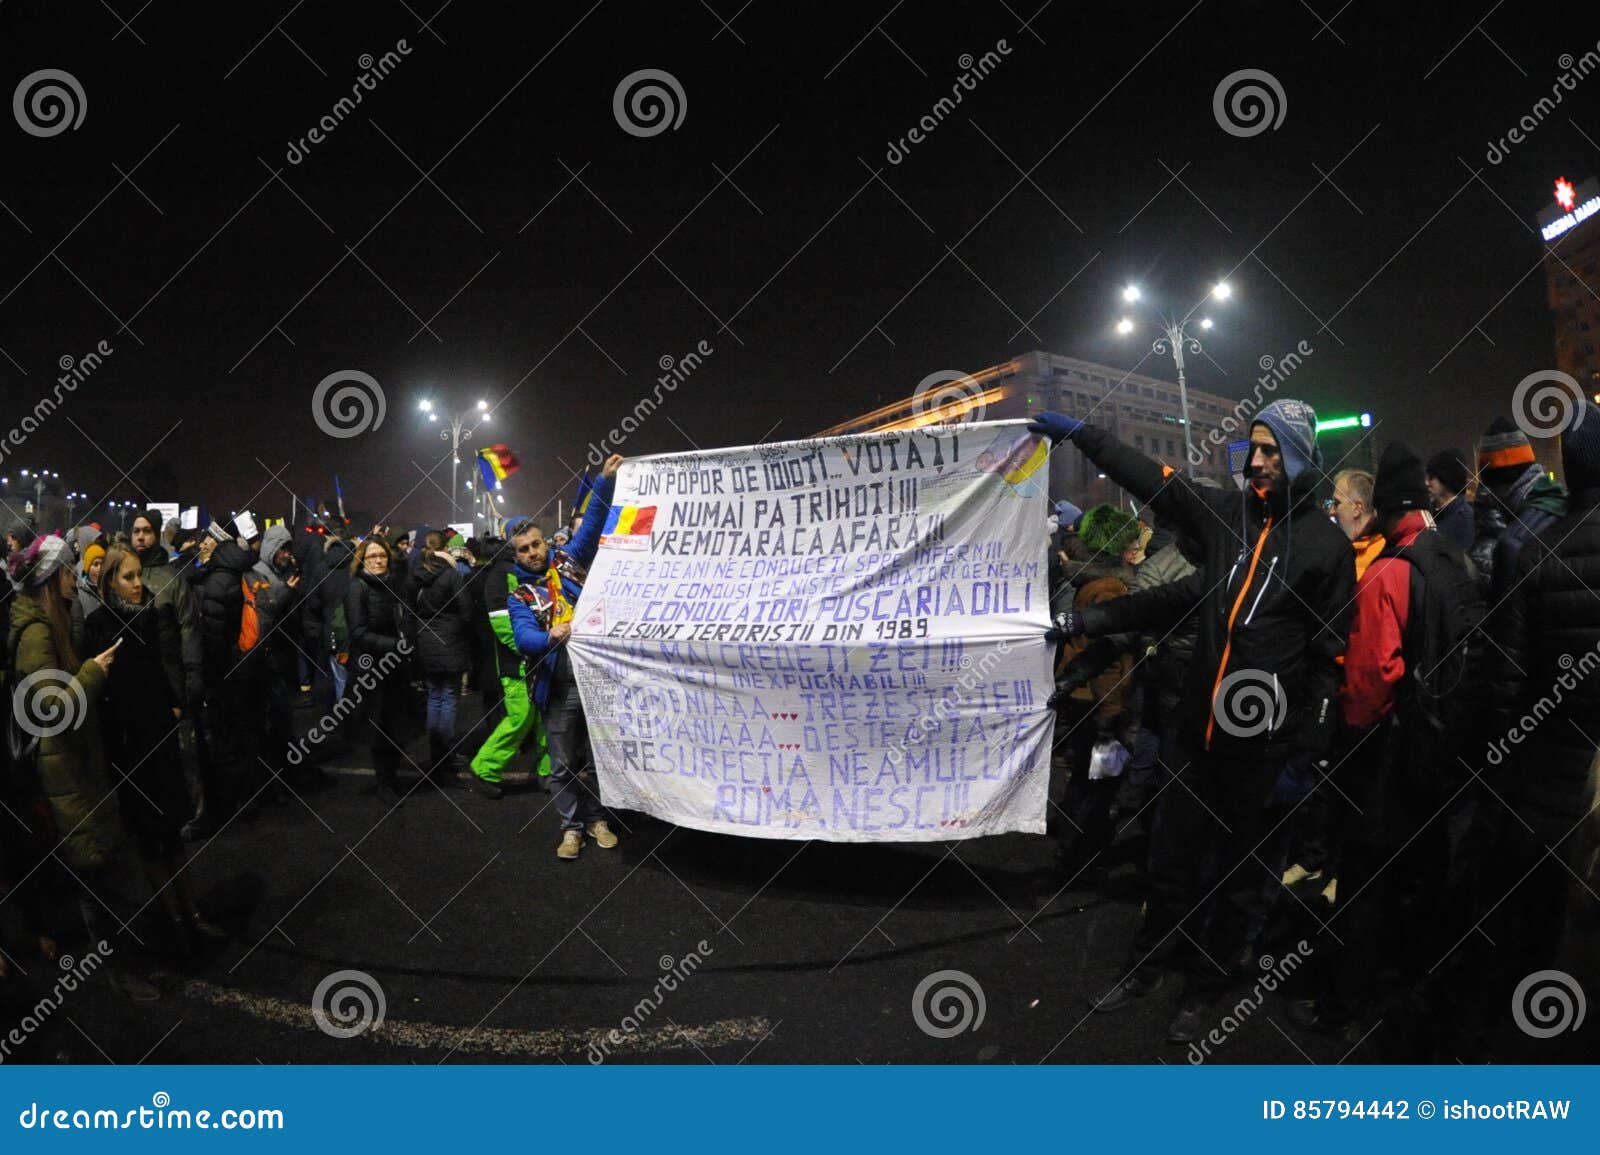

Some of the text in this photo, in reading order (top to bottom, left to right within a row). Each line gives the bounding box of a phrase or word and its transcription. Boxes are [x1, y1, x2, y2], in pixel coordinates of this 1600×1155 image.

[638, 473, 661, 496] UN
[666, 467, 724, 496] POPOR
[732, 465, 759, 493] DE
[670, 496, 744, 529] NUMAI
[822, 623, 864, 641] DIN
[876, 617, 928, 640] 1989
